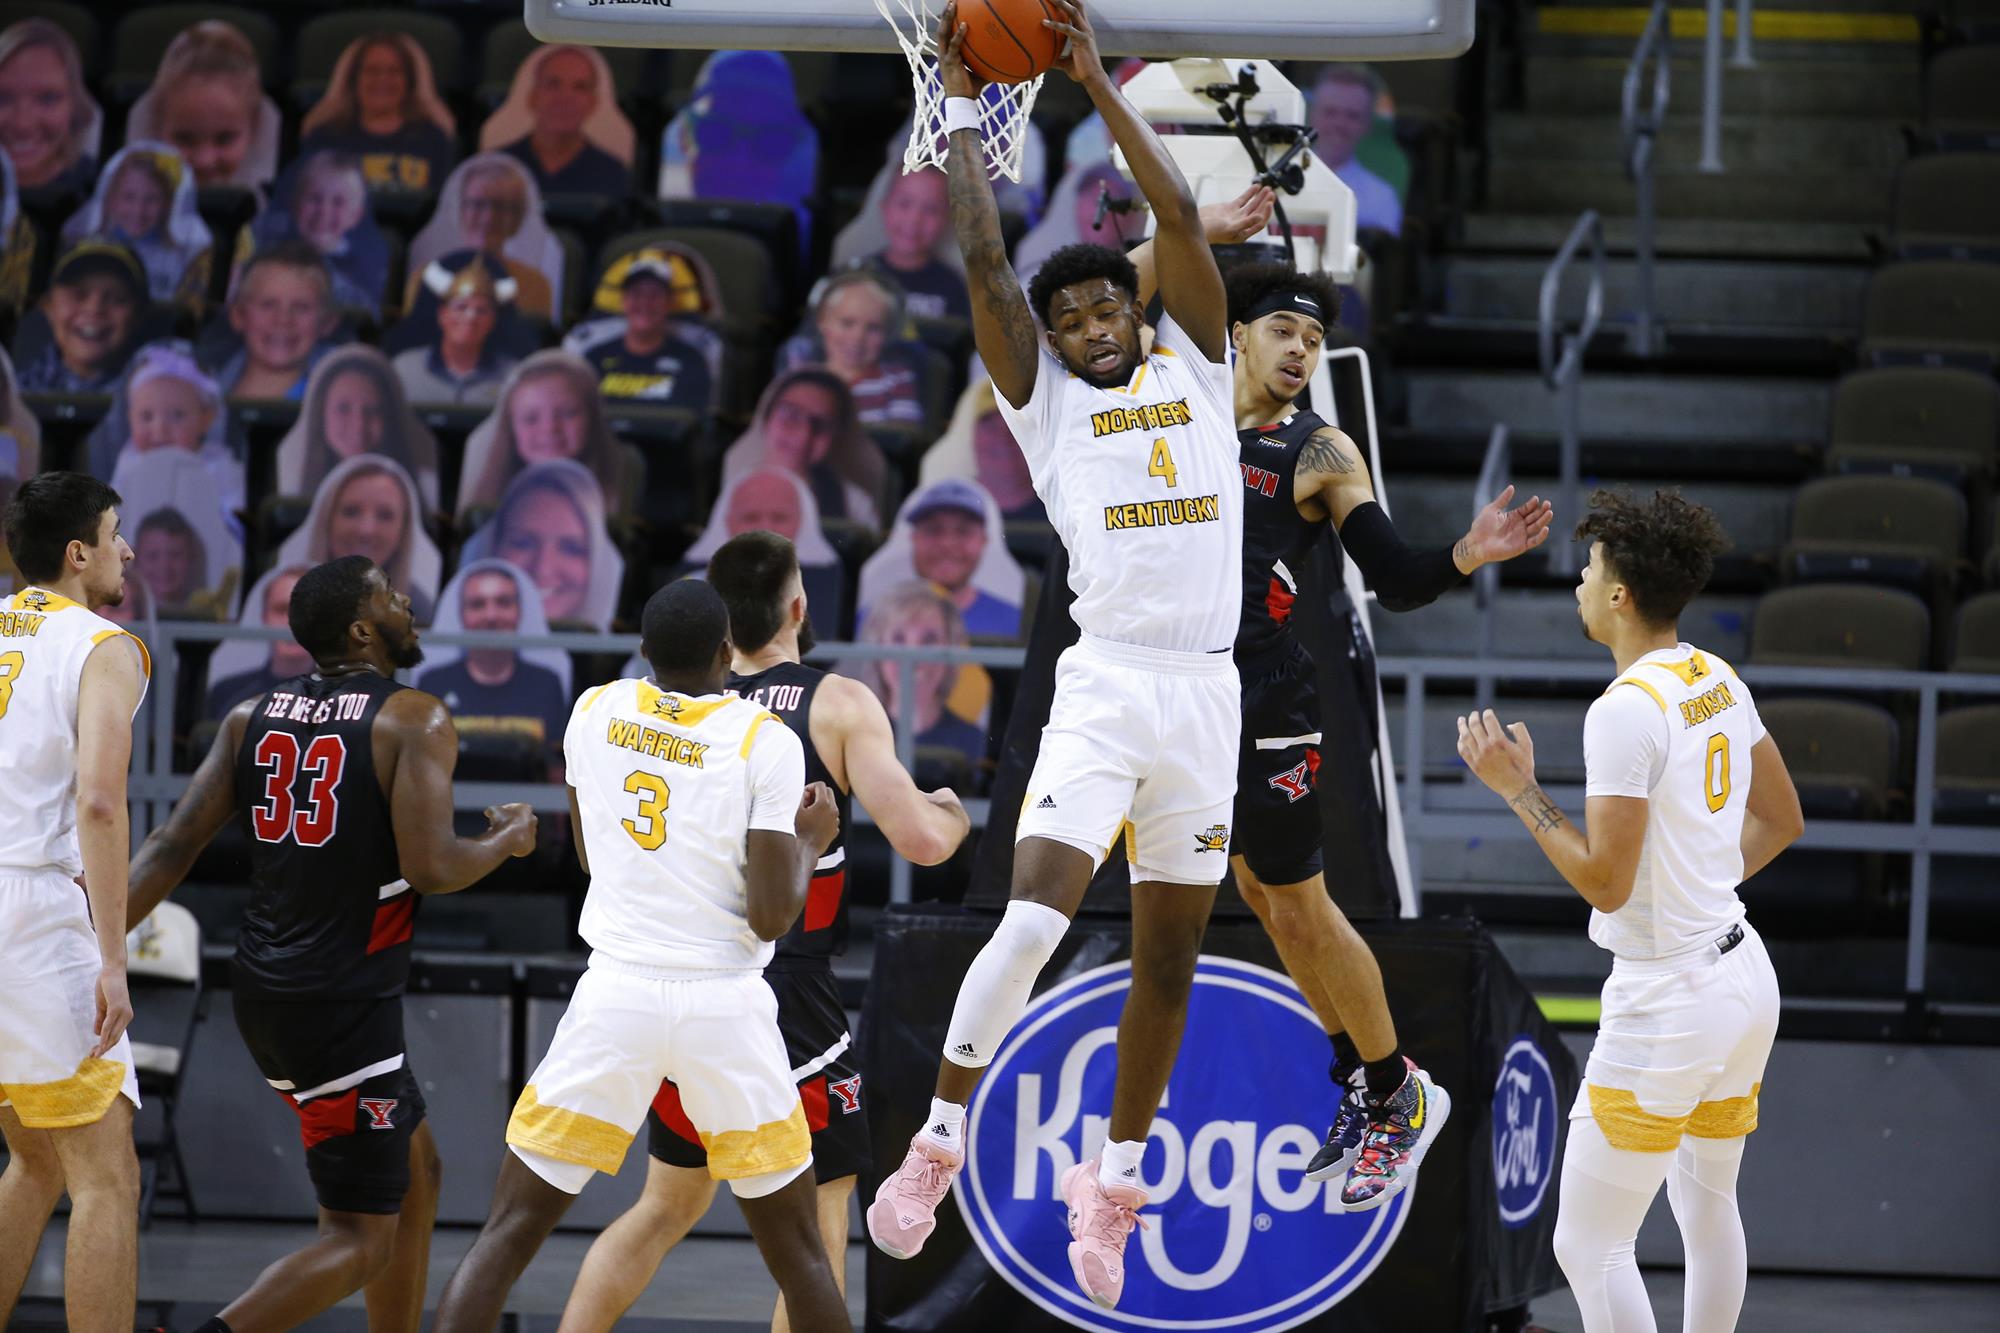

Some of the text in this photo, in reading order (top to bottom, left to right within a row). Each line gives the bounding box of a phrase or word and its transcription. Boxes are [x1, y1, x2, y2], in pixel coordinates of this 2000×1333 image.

[1091, 397, 1193, 438] NORTHERN
[1148, 437, 1178, 488] 4
[1104, 494, 1219, 530] KENTUCKY
[334, 693, 370, 721] YOU
[766, 685, 805, 711] YOU
[1679, 681, 1738, 730] ROBINSON
[607, 717, 710, 769] WARRICK
[251, 730, 347, 848] 33
[1268, 759, 1310, 803] Y
[1704, 732, 1731, 814] 0
[621, 769, 671, 851] 3
[953, 1046, 978, 1058] adidas
[359, 1097, 399, 1130] Y
[828, 1072, 862, 1115] Y
[1012, 1024, 1347, 1291] Koge
